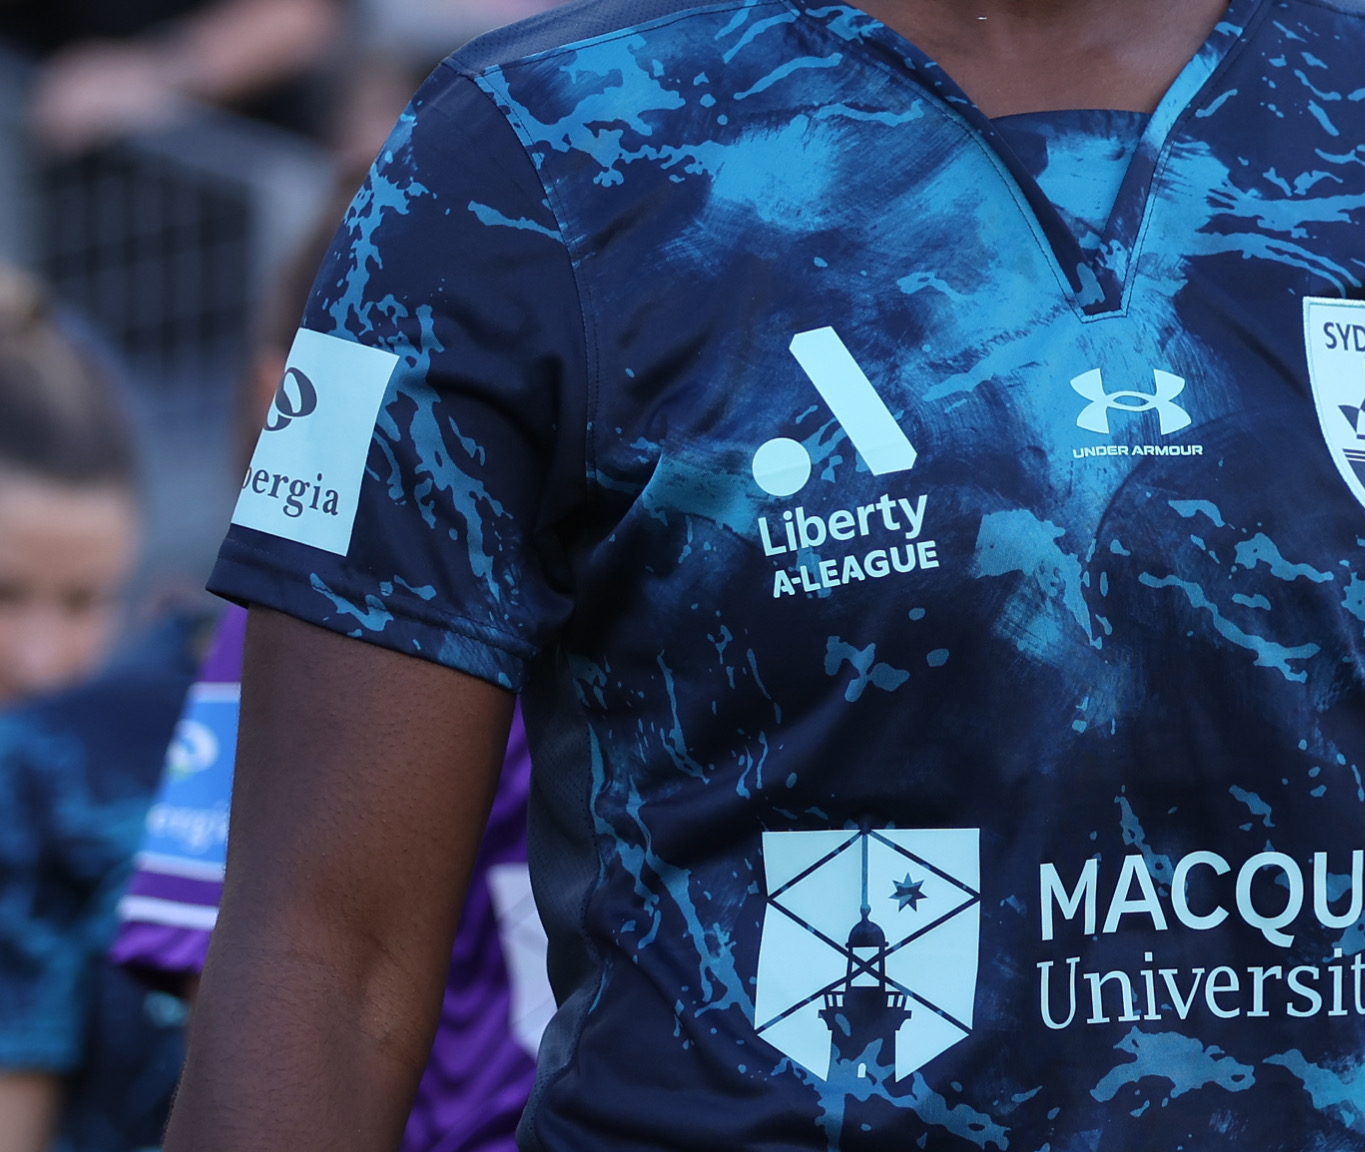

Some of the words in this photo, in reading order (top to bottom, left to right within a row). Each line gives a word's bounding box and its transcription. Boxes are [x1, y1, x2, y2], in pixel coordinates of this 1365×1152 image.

[1072, 444, 1129, 459] UNDER
[1131, 444, 1204, 456] ARMOUR
[756, 493, 929, 557] Liberty
[772, 539, 940, 599] A-LEAGUE
